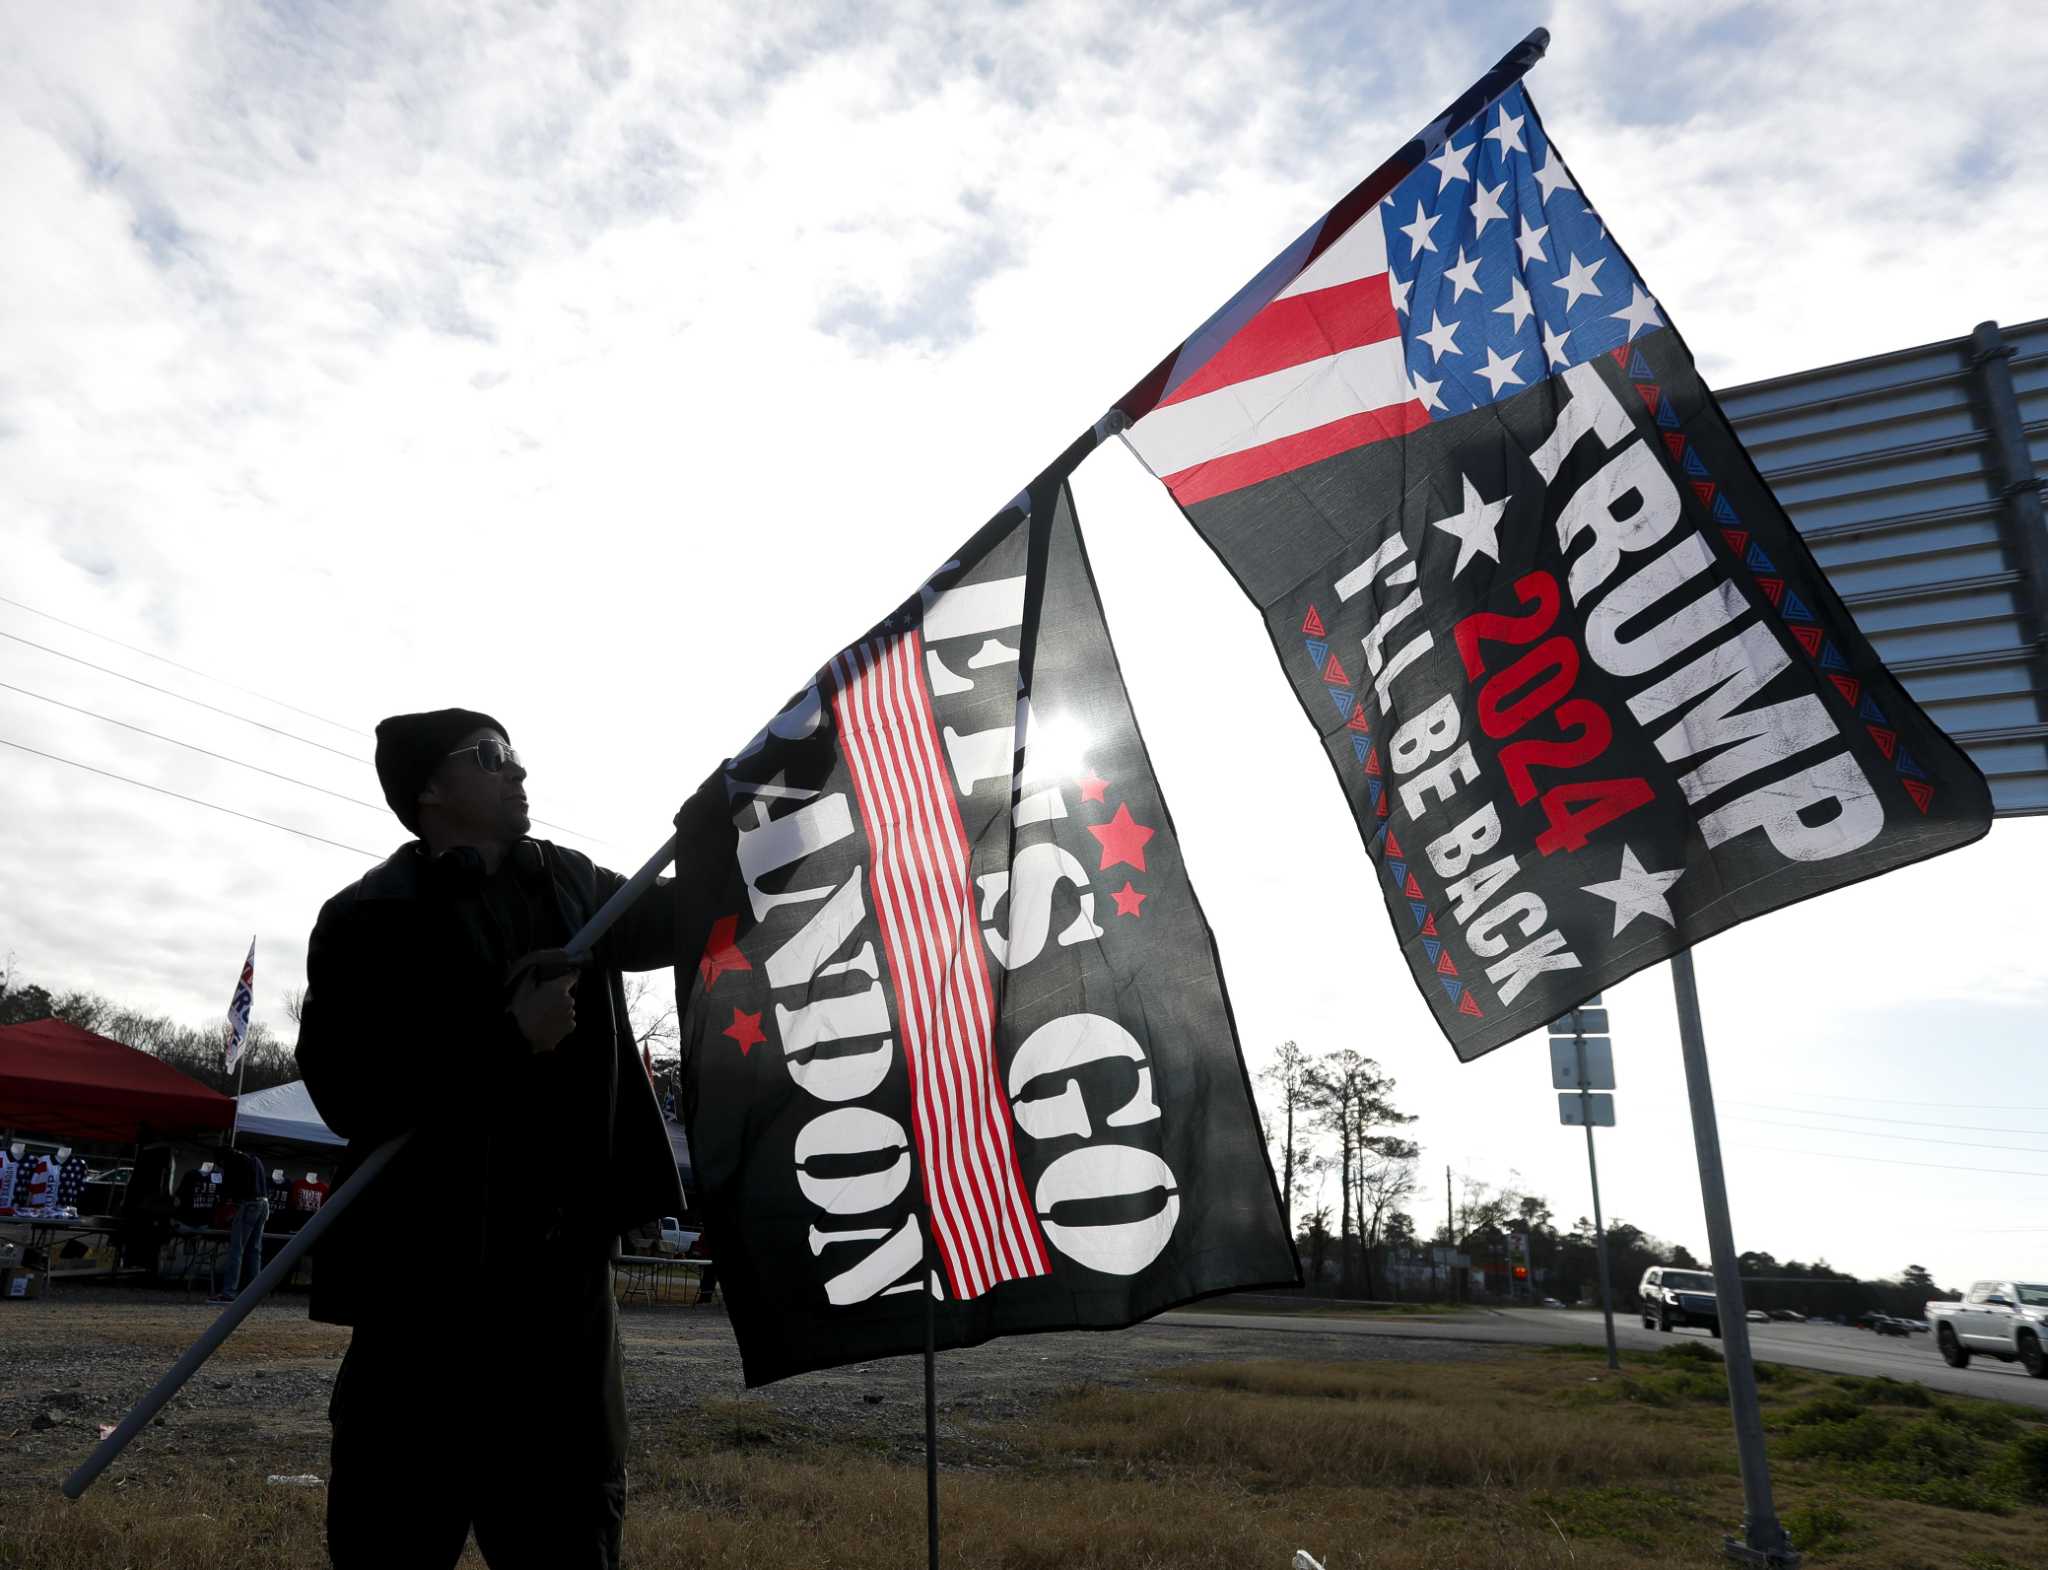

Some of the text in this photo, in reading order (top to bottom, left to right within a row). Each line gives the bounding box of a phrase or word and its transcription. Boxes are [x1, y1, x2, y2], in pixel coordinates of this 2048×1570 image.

[1334, 531, 1582, 1007] I'LL BE BACK
[1454, 571, 1655, 857] 2024
[1528, 361, 1885, 863] TRUMP
[920, 560, 1181, 1276] ET'S GO
